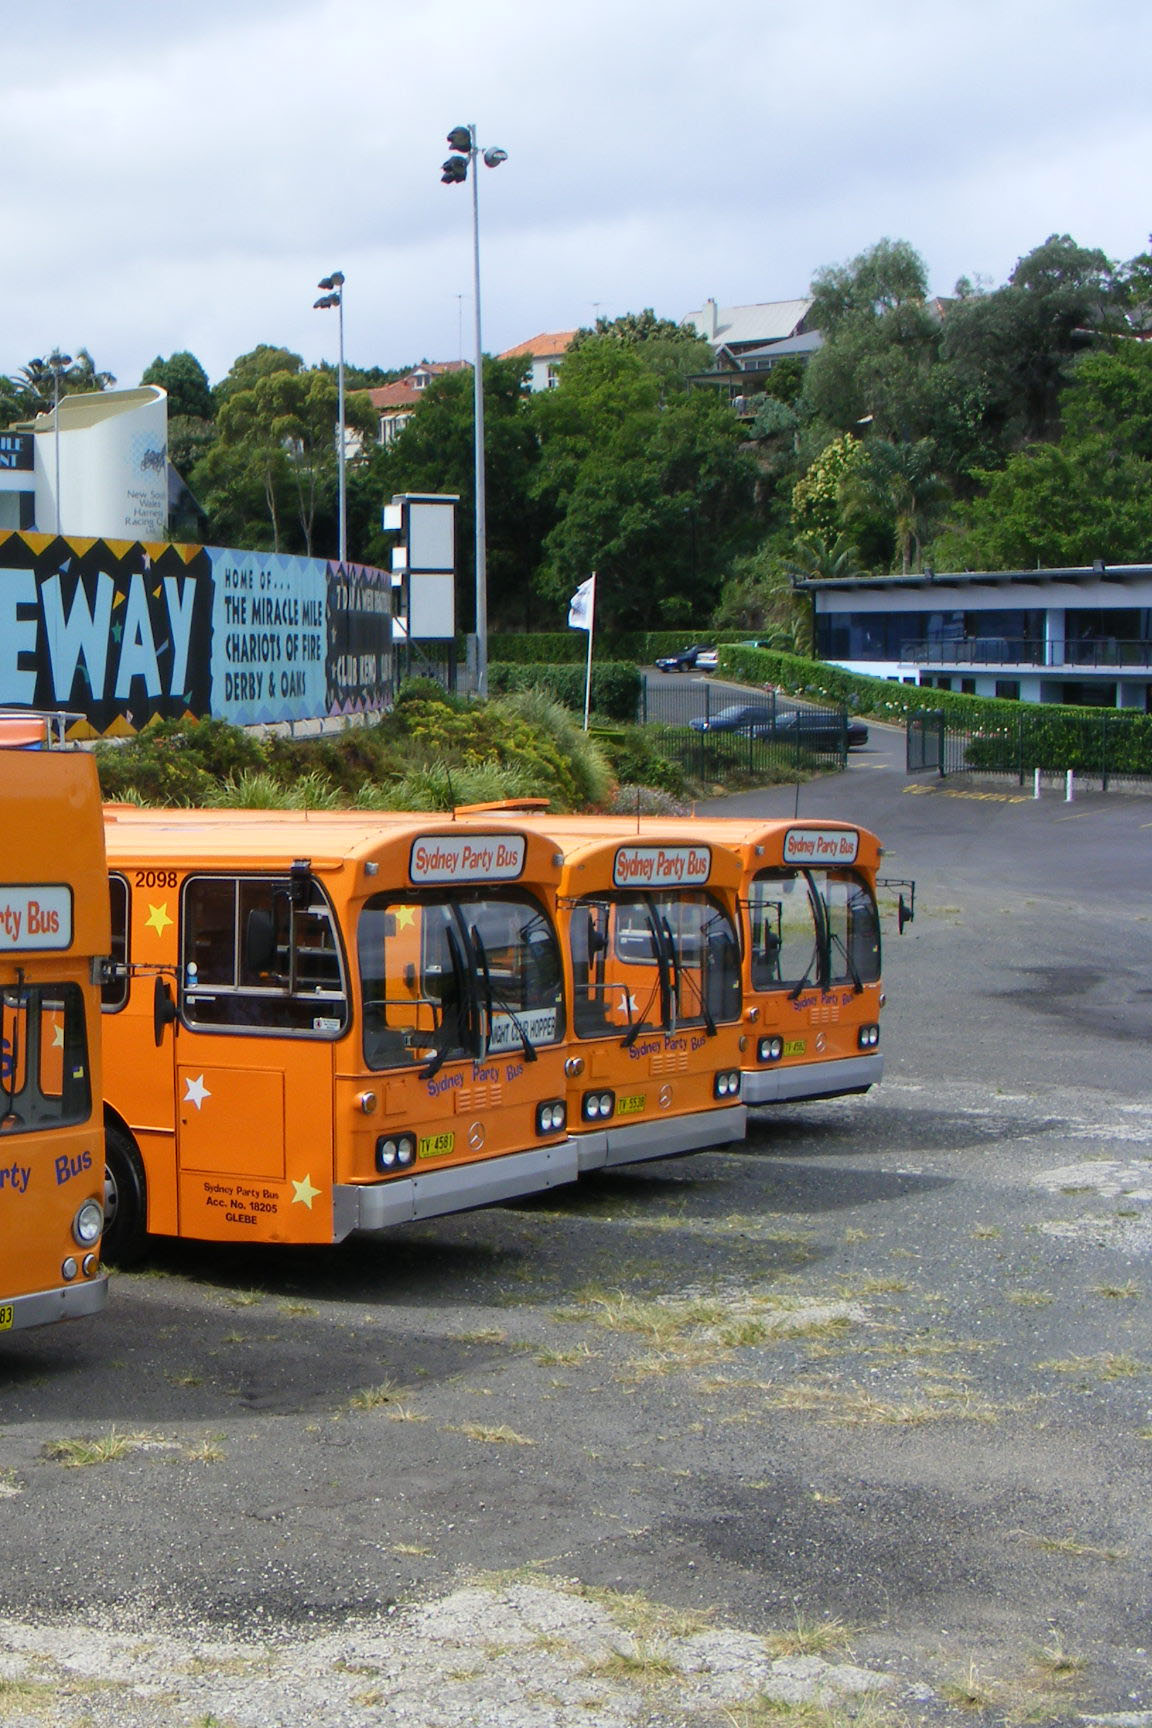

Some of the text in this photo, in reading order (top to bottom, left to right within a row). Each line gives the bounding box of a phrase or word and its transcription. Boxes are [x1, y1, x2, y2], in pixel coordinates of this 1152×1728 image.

[225, 568, 253, 589] HOME
[224, 596, 322, 627] THE MIRACLE MILE
[225, 633, 321, 662] CHARIOTS OF FIRE
[225, 670, 306, 702] DERBY & OAKS
[415, 844, 518, 874] Sydney Party Bus
[788, 835, 854, 856] Sydney Party Bus
[617, 849, 707, 881] Sydney Party Bus
[135, 871, 178, 889] 2098
[27, 901, 60, 934] Bus
[530, 1015, 556, 1039] HOPPER
[629, 1034, 706, 1060] Sydney Party Bus
[427, 1062, 524, 1097] Sydney Party Bus
[54, 1150, 93, 1186] Bus
[203, 1182, 279, 1200] Sydney Party Bus
[206, 1196, 278, 1214] Acc. No. 18205
[225, 1212, 257, 1225] GLEBE
